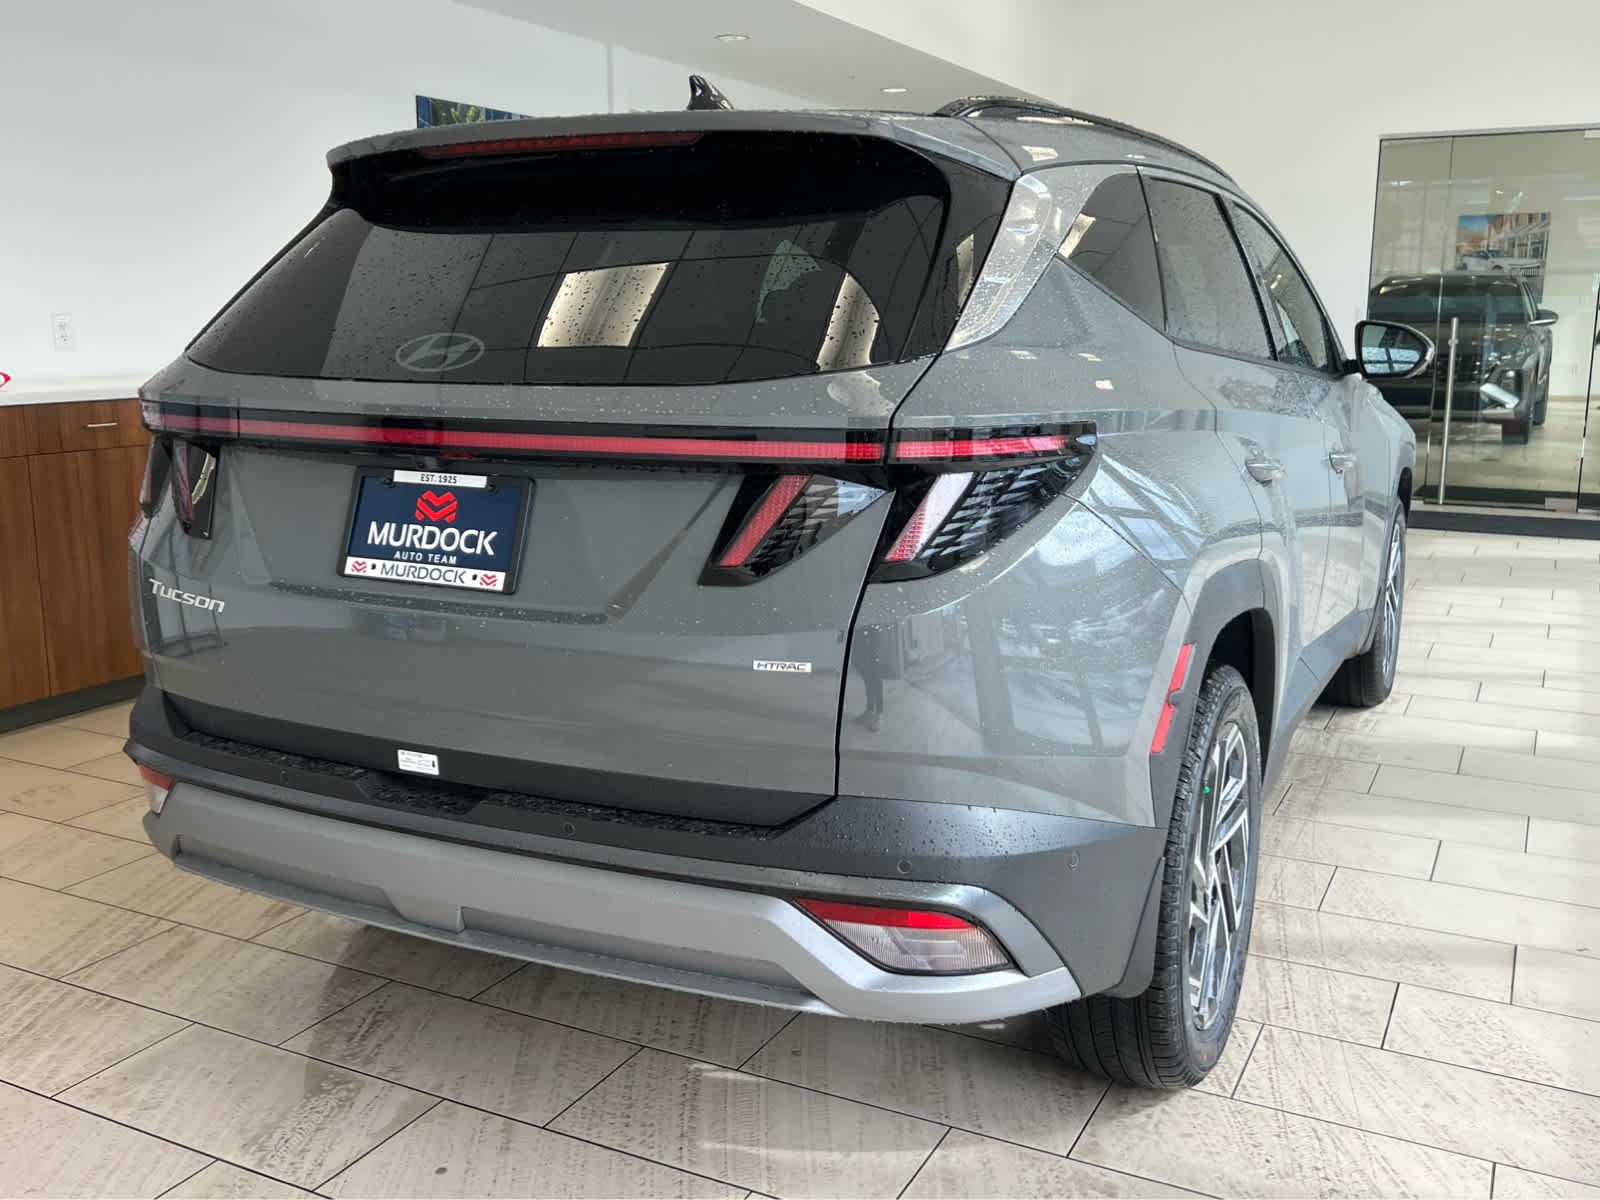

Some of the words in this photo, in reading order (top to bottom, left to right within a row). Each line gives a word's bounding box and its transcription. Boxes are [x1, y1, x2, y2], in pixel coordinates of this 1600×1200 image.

[420, 473, 438, 483] EST.
[438, 474, 457, 484] 1925
[367, 520, 498, 556] MURDOCK
[393, 551, 423, 561] AUTO
[428, 553, 457, 565] TEAM
[380, 563, 467, 584] MURDOCK
[755, 661, 808, 671] HTRAC
